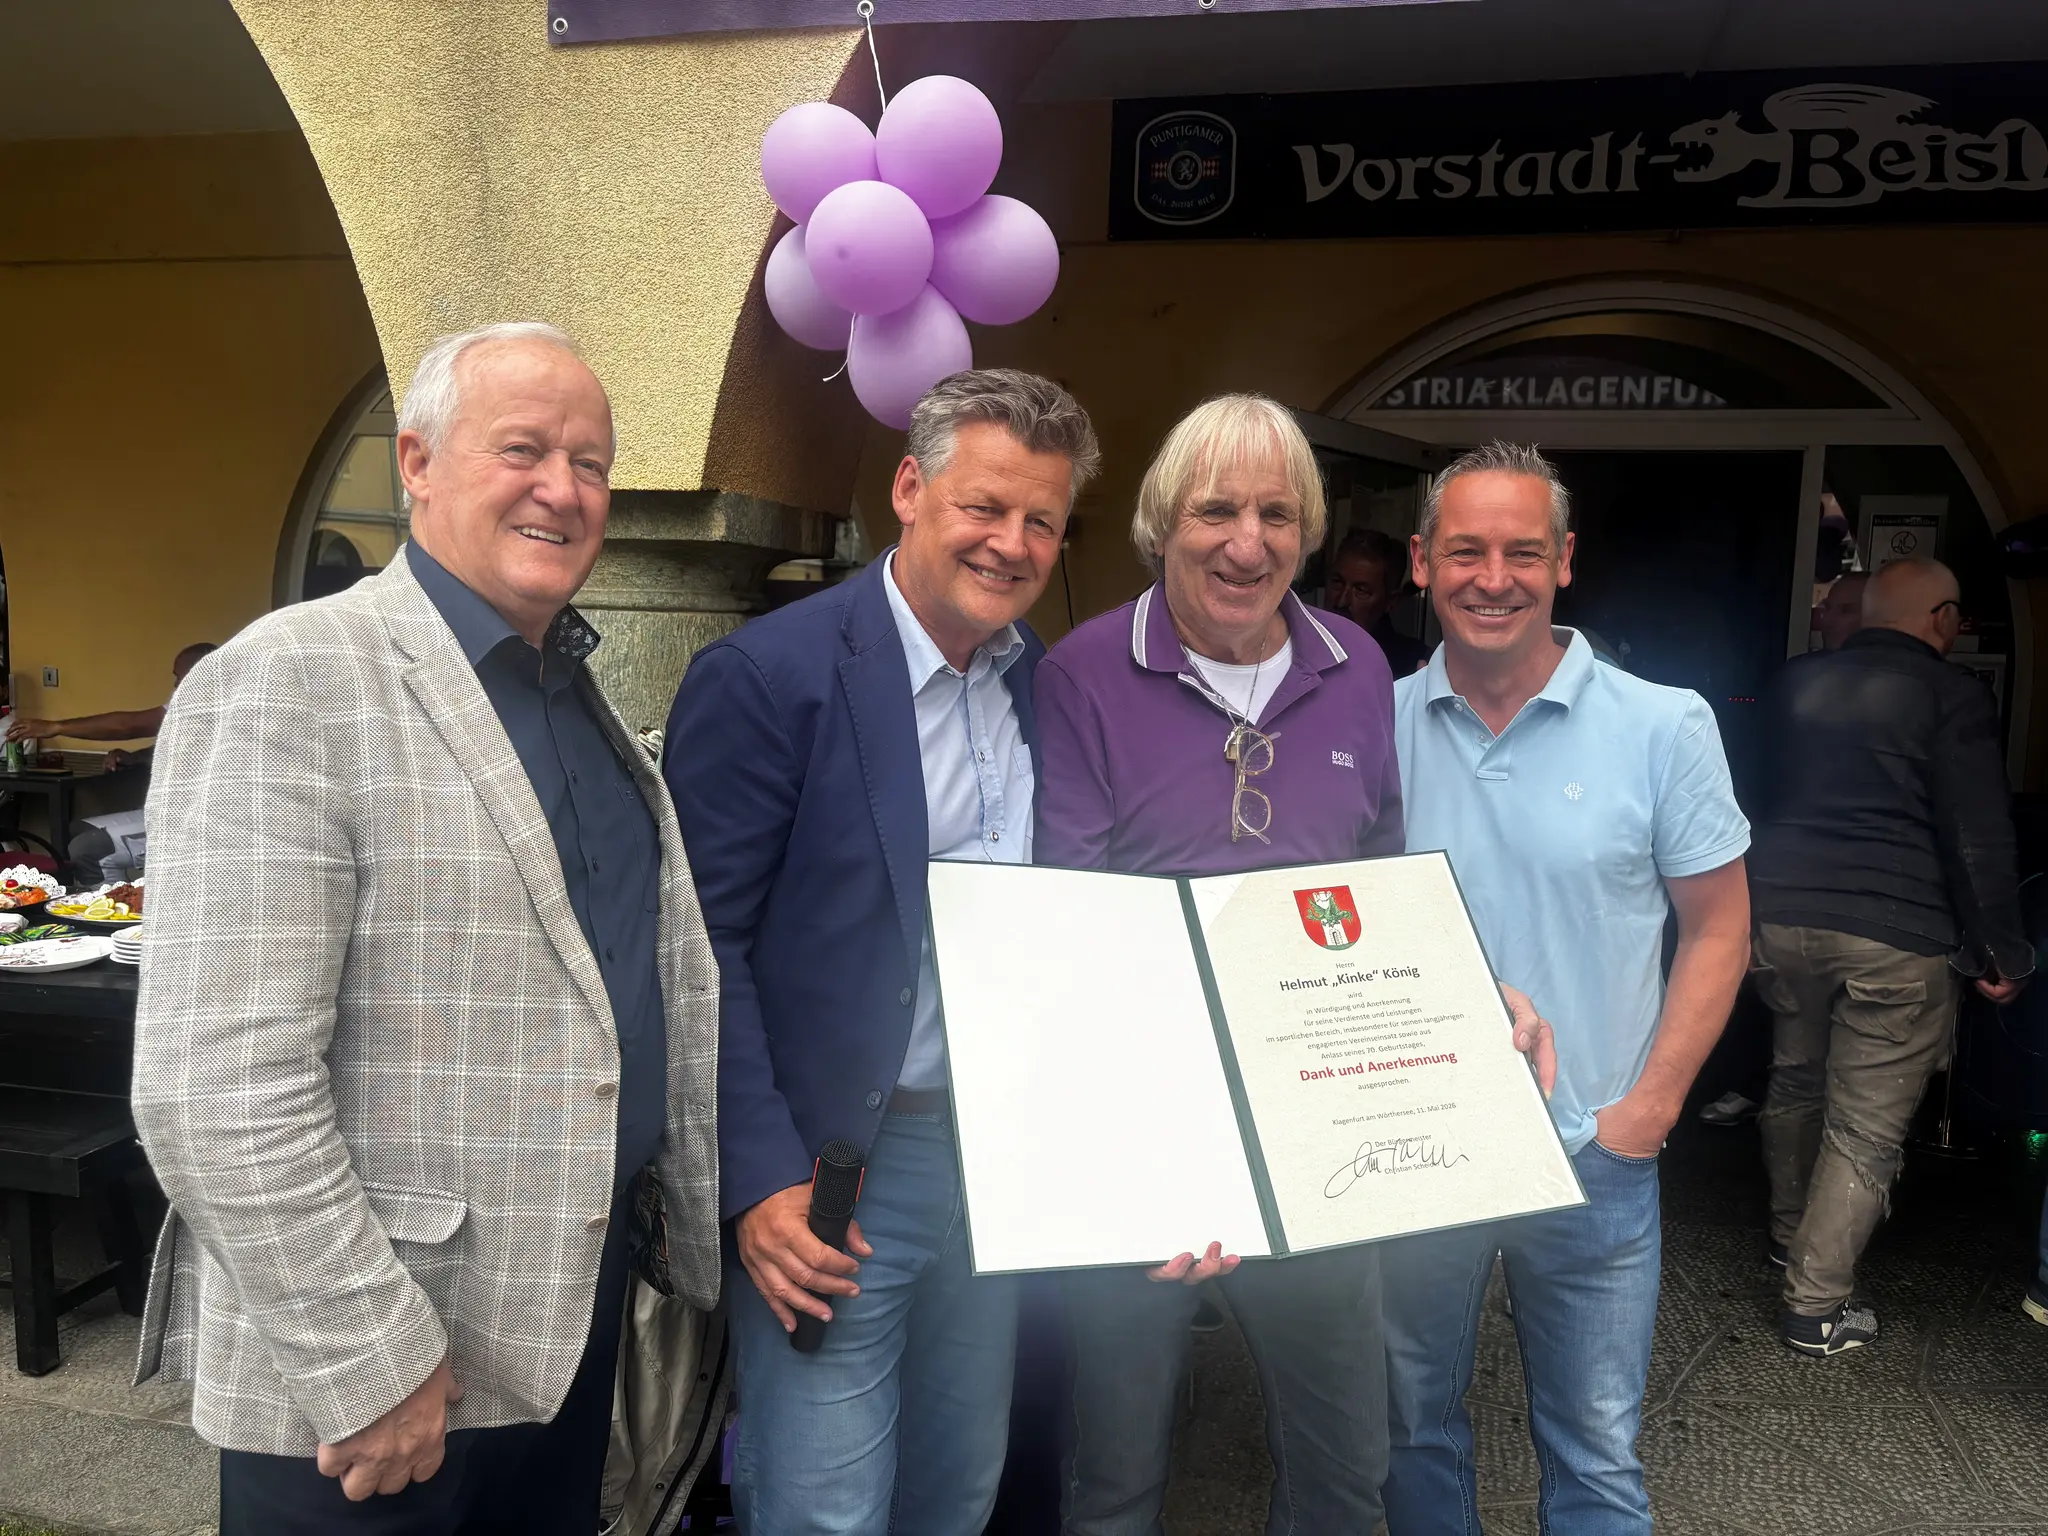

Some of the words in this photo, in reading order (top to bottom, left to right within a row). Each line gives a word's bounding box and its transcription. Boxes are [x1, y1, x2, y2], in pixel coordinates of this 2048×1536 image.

[1149, 124, 1223, 148] PUNTIGAMER
[1292, 130, 1677, 203] Vorstadt-
[1332, 750, 1354, 764] BOSS
[1279, 976, 1328, 991] Helmut
[1332, 969, 1378, 987] „Kinke“
[1382, 965, 1420, 979] König
[1313, 1004, 1351, 1014] Würdigung
[1351, 1001, 1365, 1010] und
[1366, 997, 1411, 1008] Anerkennung
[1347, 991, 1363, 999] wird
[1276, 1032, 1314, 1042] sportlichen
[1314, 1028, 1342, 1037] Bereich,
[1343, 1023, 1388, 1033] insbesondere
[1389, 1020, 1399, 1028] für
[1400, 1018, 1423, 1026] seinen
[1423, 1013, 1465, 1023] langjährigen
[1304, 1019, 1314, 1027] für
[1315, 1018, 1333, 1026] seine
[1334, 1013, 1370, 1023] Verdienste
[1372, 1011, 1385, 1019] und
[1386, 1007, 1422, 1017] Leistungen
[1307, 1039, 1347, 1050] engagierten
[1348, 1034, 1397, 1044] Vereinseinsatz
[1398, 1030, 1418, 1038] sowie
[1419, 1028, 1432, 1036] aus
[1321, 1052, 1343, 1060] Anlass
[1344, 1049, 1366, 1057] seines
[1366, 1046, 1377, 1054] 70.
[1378, 1041, 1425, 1052] Geburtstages,
[1299, 1066, 1336, 1081] Dank
[1337, 1062, 1364, 1076] und
[1368, 1053, 1458, 1073] Anerkennung
[1358, 1078, 1411, 1090] ausgesprochen.
[1332, 1115, 1365, 1126] Klagenfurt
[1376, 1109, 1416, 1119] Wörthersee,
[1440, 1102, 1457, 1110] 2026
[1384, 1165, 1413, 1175] Christian
[1413, 1162, 1440, 1170] Scheid
